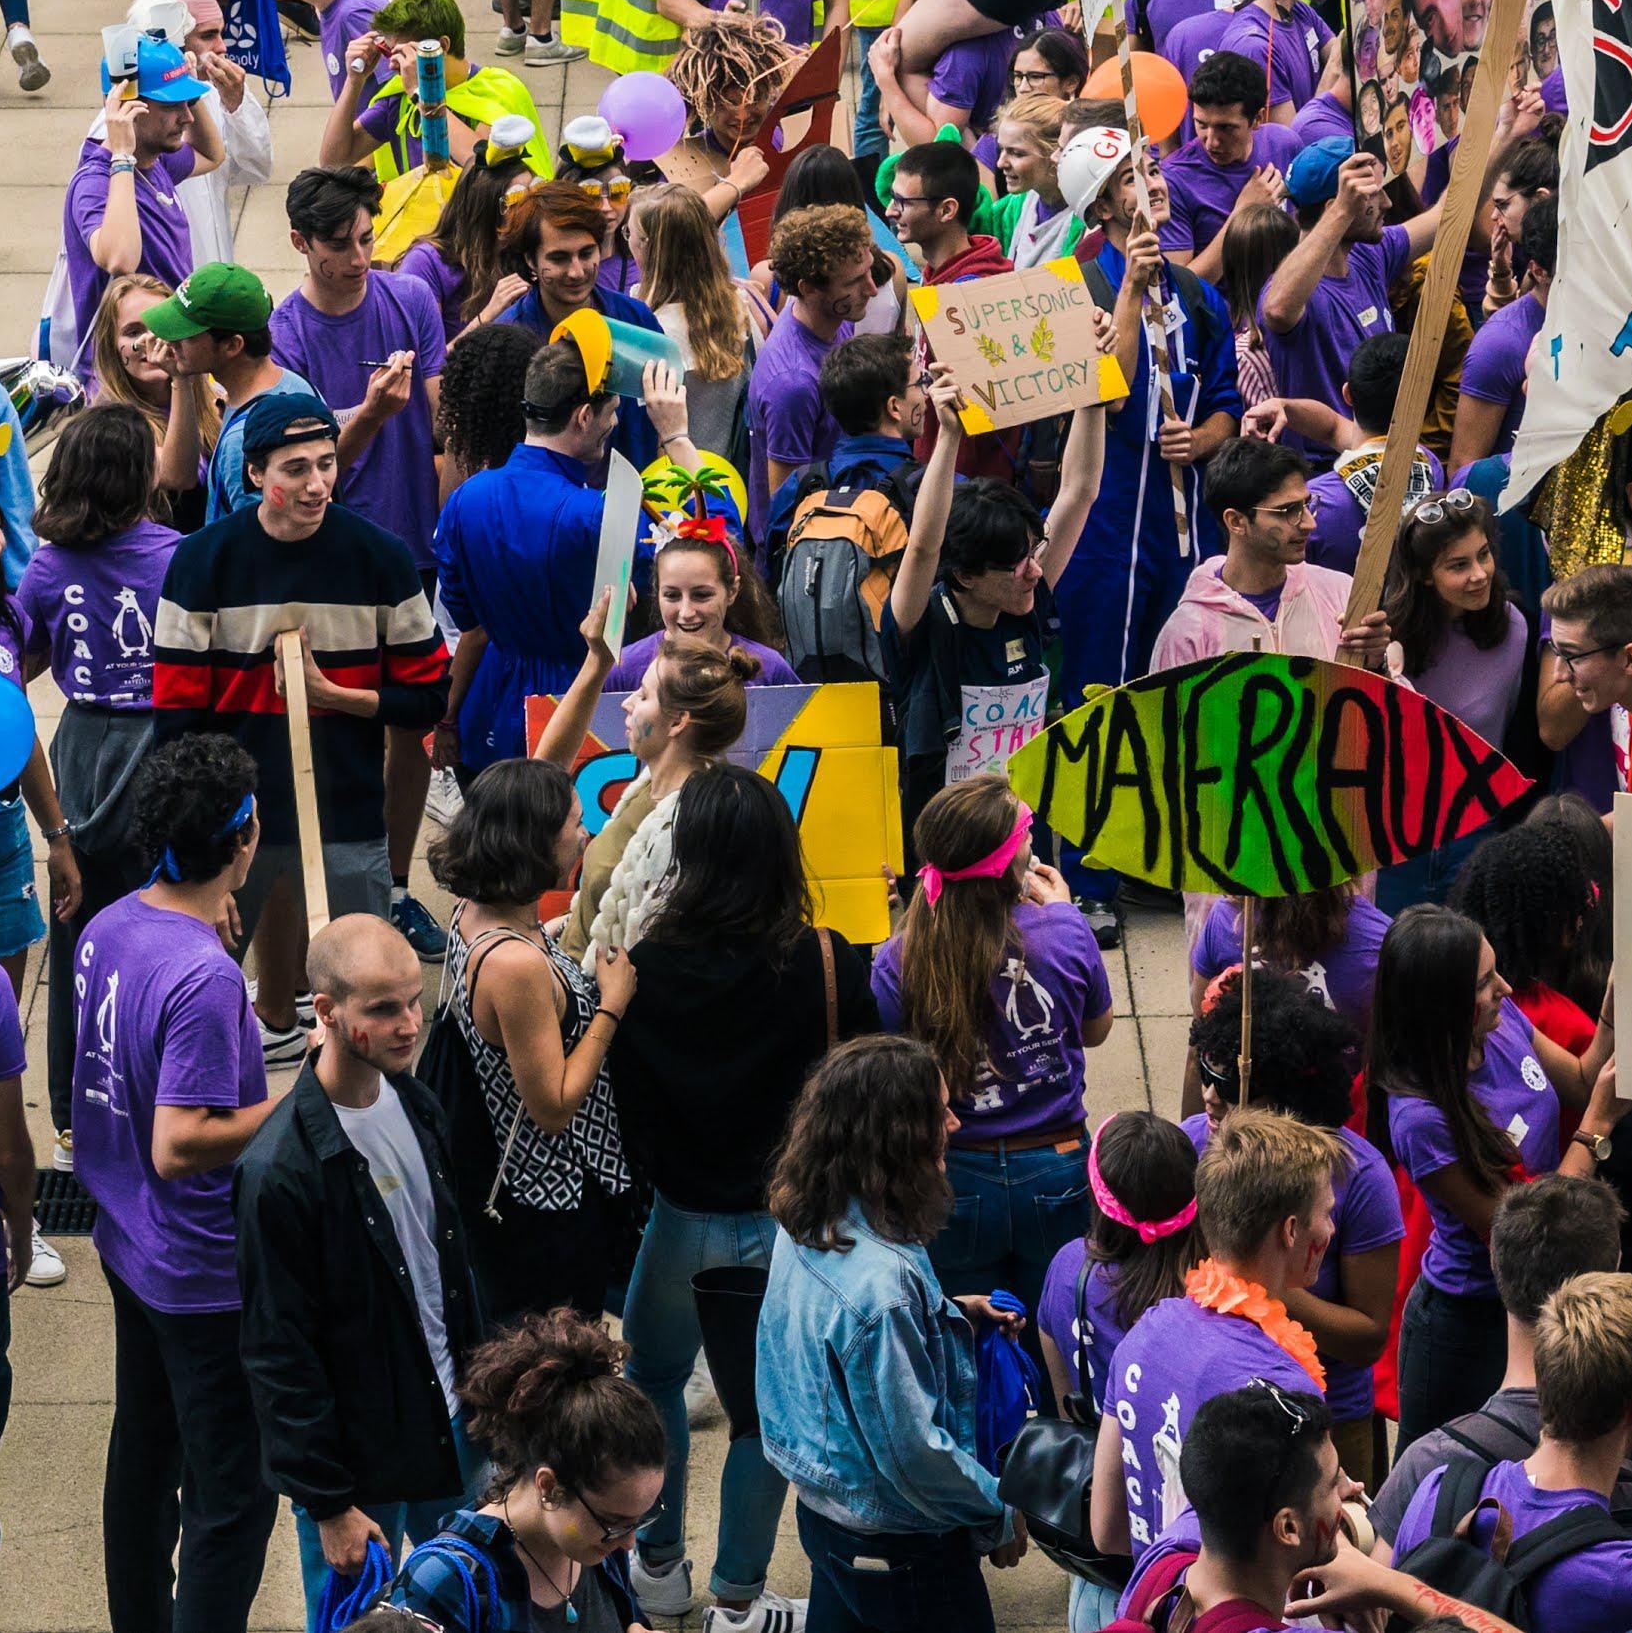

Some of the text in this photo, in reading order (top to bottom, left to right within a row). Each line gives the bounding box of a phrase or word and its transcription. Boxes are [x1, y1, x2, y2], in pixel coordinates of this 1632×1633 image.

[1012, 333, 1030, 358] &
[972, 358, 1089, 413] VICTORY
[1116, 1362, 1152, 1546] COACH
